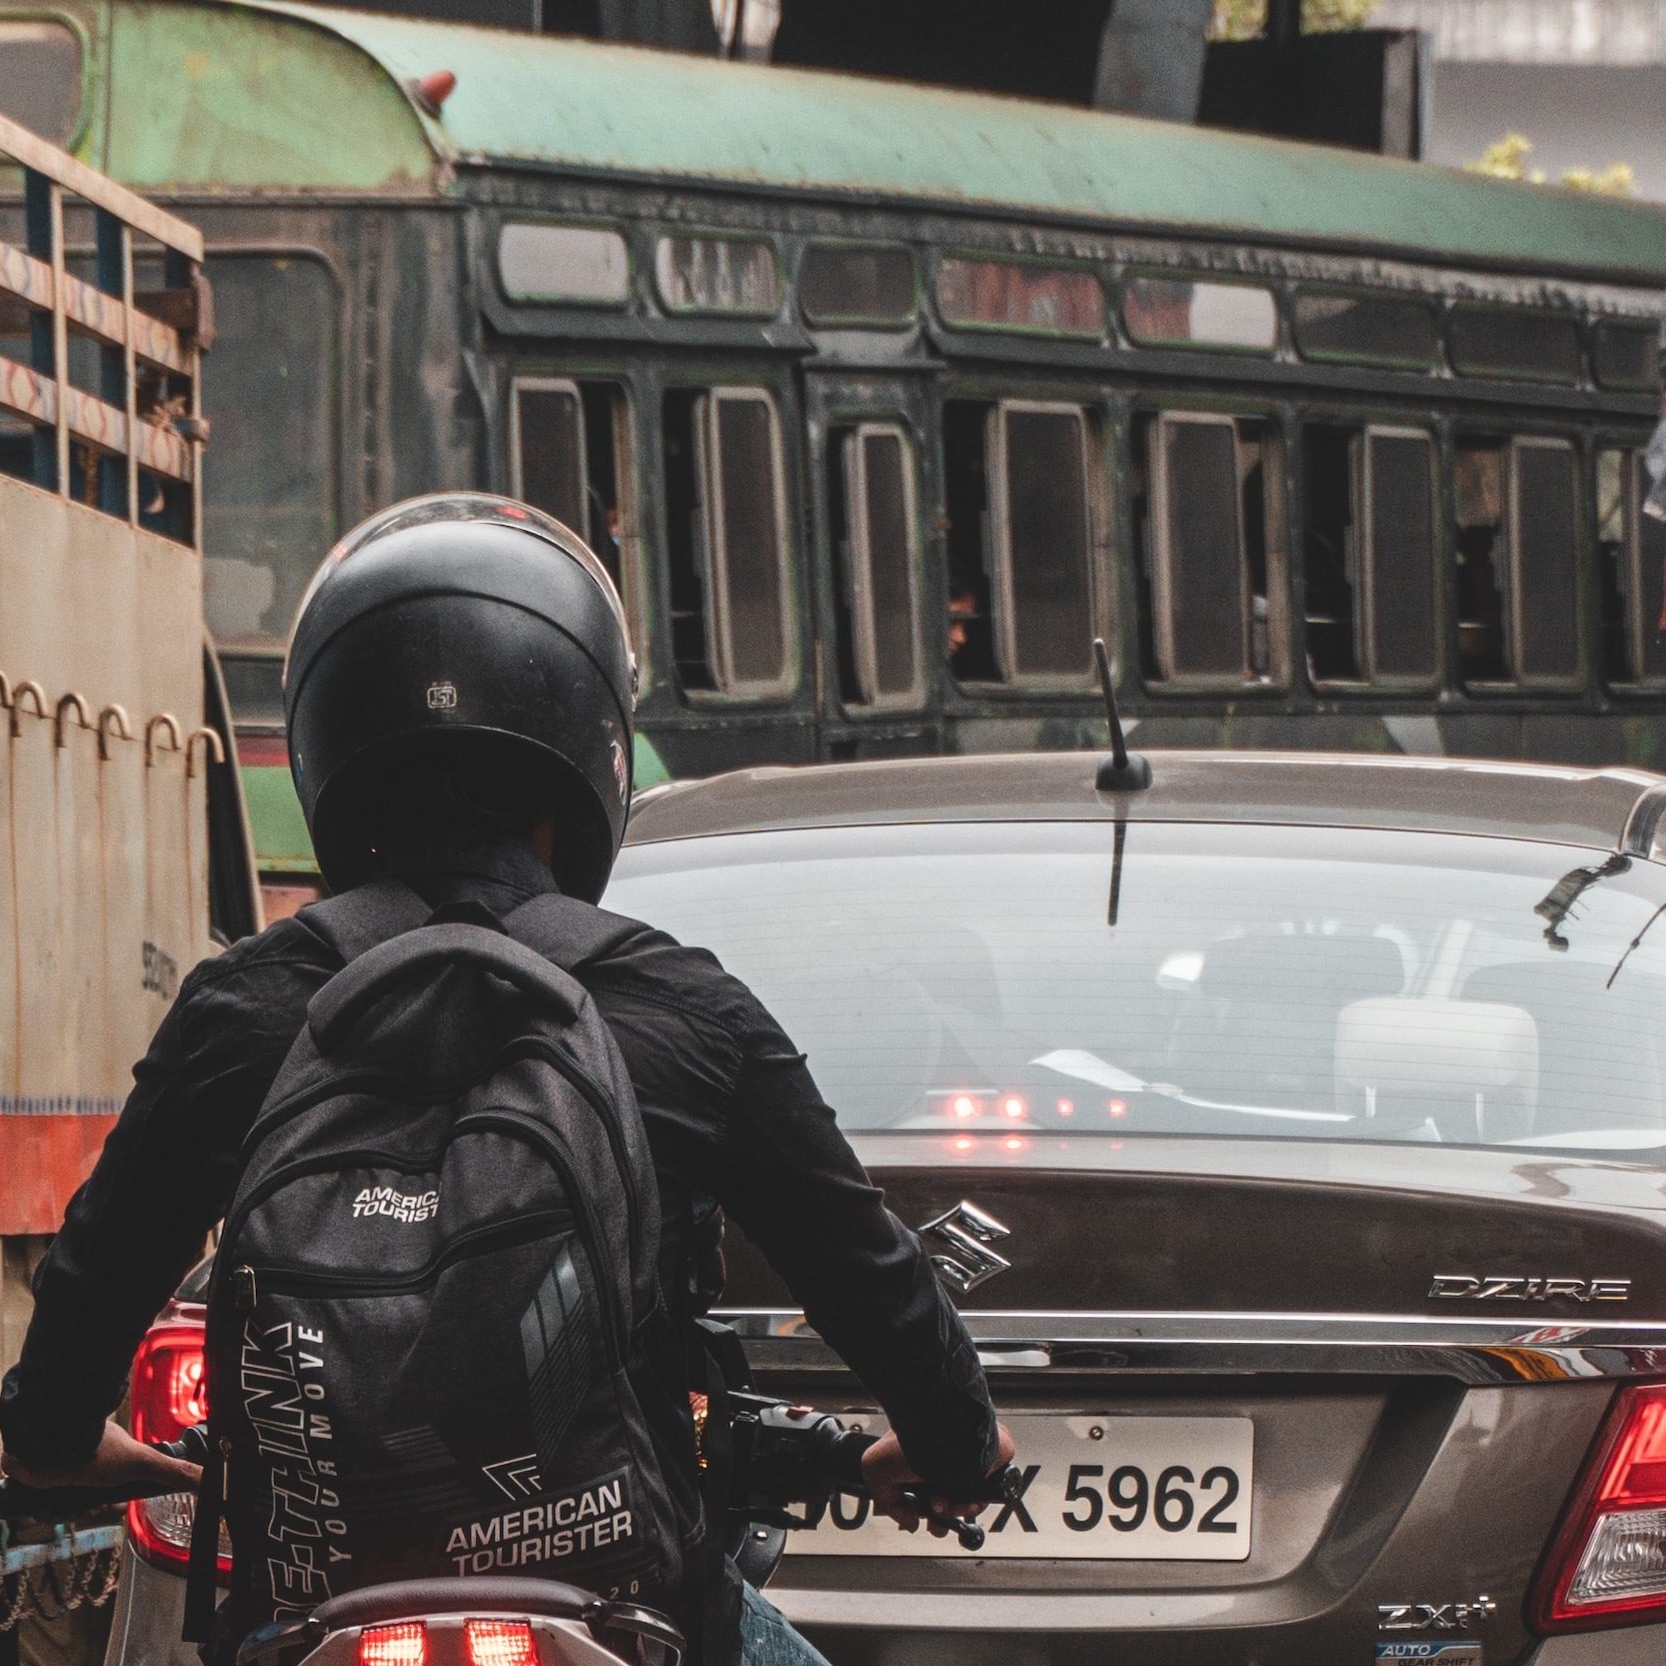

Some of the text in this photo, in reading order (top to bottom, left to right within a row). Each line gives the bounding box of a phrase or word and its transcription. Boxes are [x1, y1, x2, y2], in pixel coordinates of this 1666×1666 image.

[354, 1186, 440, 1209] AMERIC
[1428, 1275, 1632, 1302] DZIRE
[240, 1317, 333, 1623] E-THINK
[297, 1324, 352, 1563] YOUR MOVE
[445, 1479, 623, 1553] AMERICAN
[1061, 1464, 1240, 1535] 5962
[452, 1510, 633, 1578] TOURISTER
[1380, 1644, 1431, 1657] AUTO
